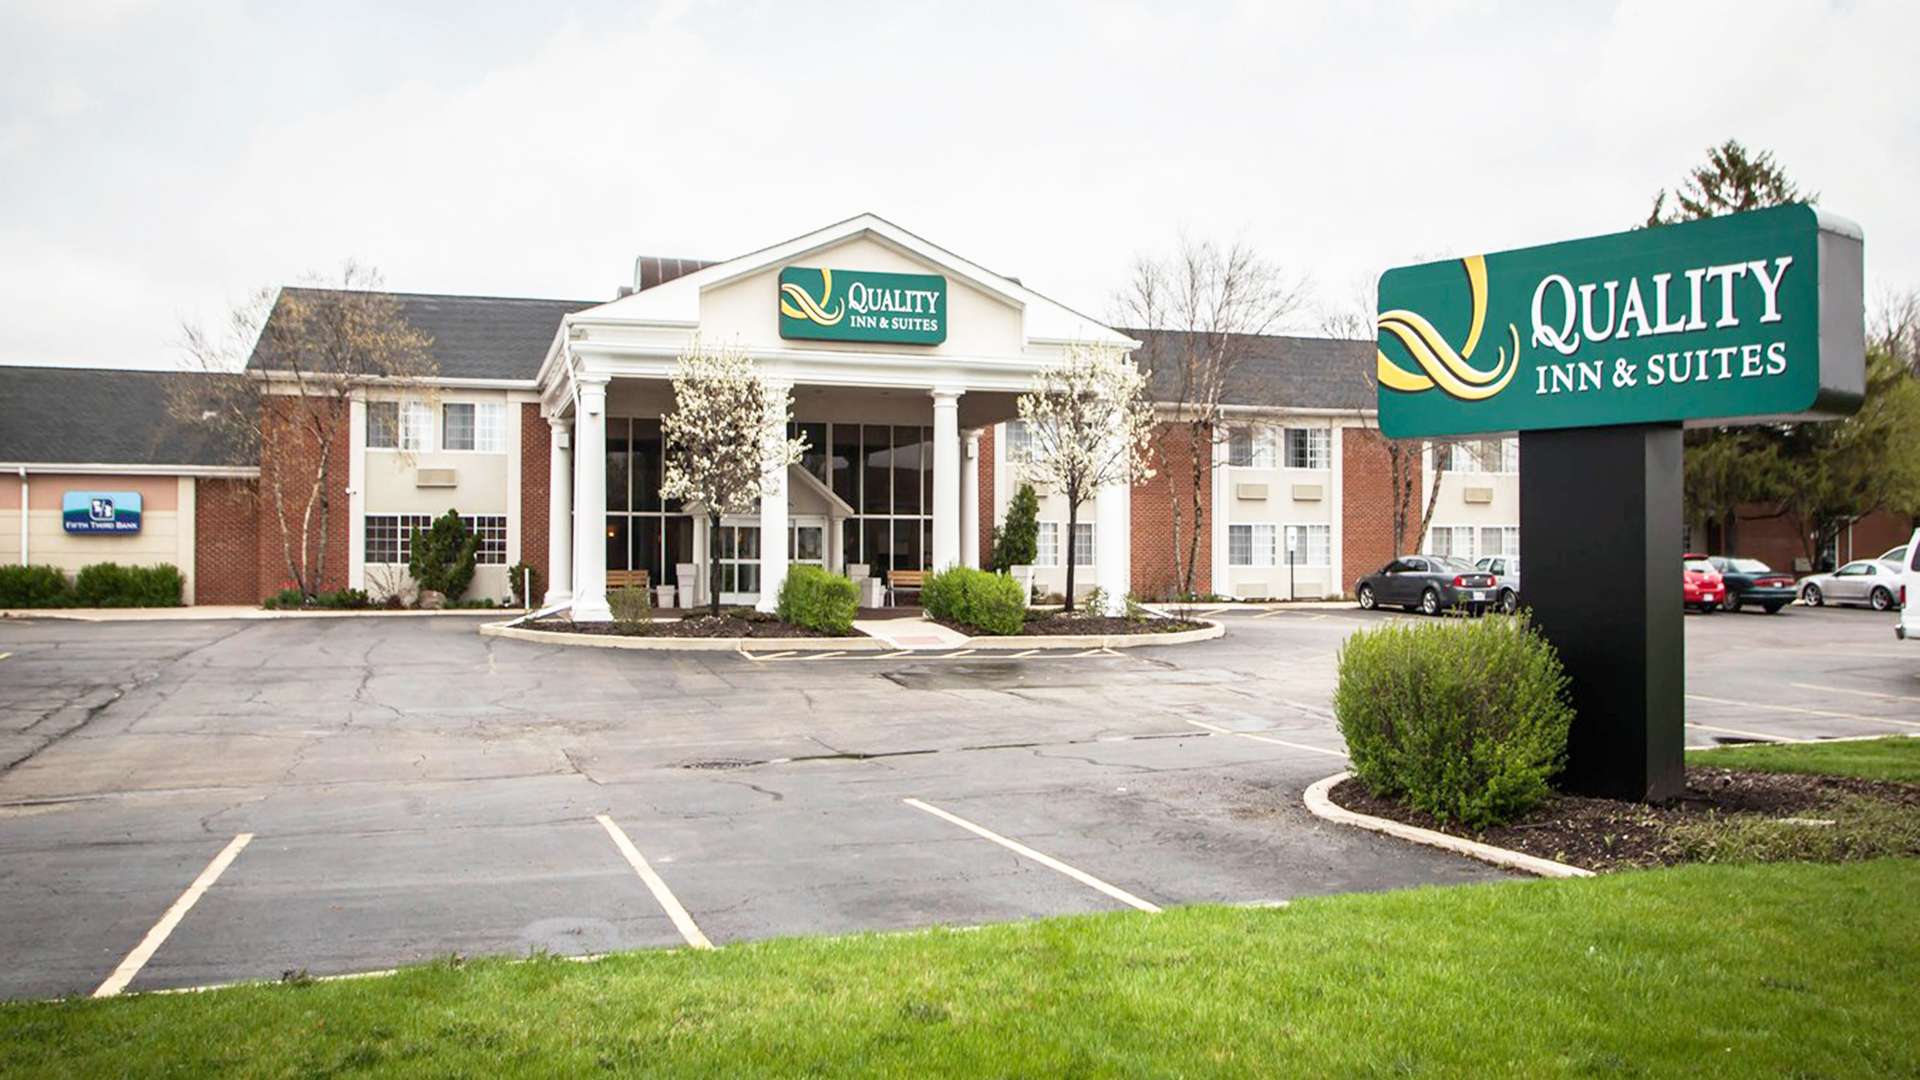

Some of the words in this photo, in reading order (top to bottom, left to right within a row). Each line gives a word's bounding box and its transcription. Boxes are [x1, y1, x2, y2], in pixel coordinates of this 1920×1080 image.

[848, 282, 940, 313] QUALITY
[1531, 256, 1793, 355] QUALITY
[850, 315, 877, 328] INN
[879, 317, 889, 329] &
[891, 317, 938, 331] SUITES
[1536, 360, 1604, 394] INN
[1612, 358, 1637, 388] &
[1647, 342, 1787, 385] SUITES
